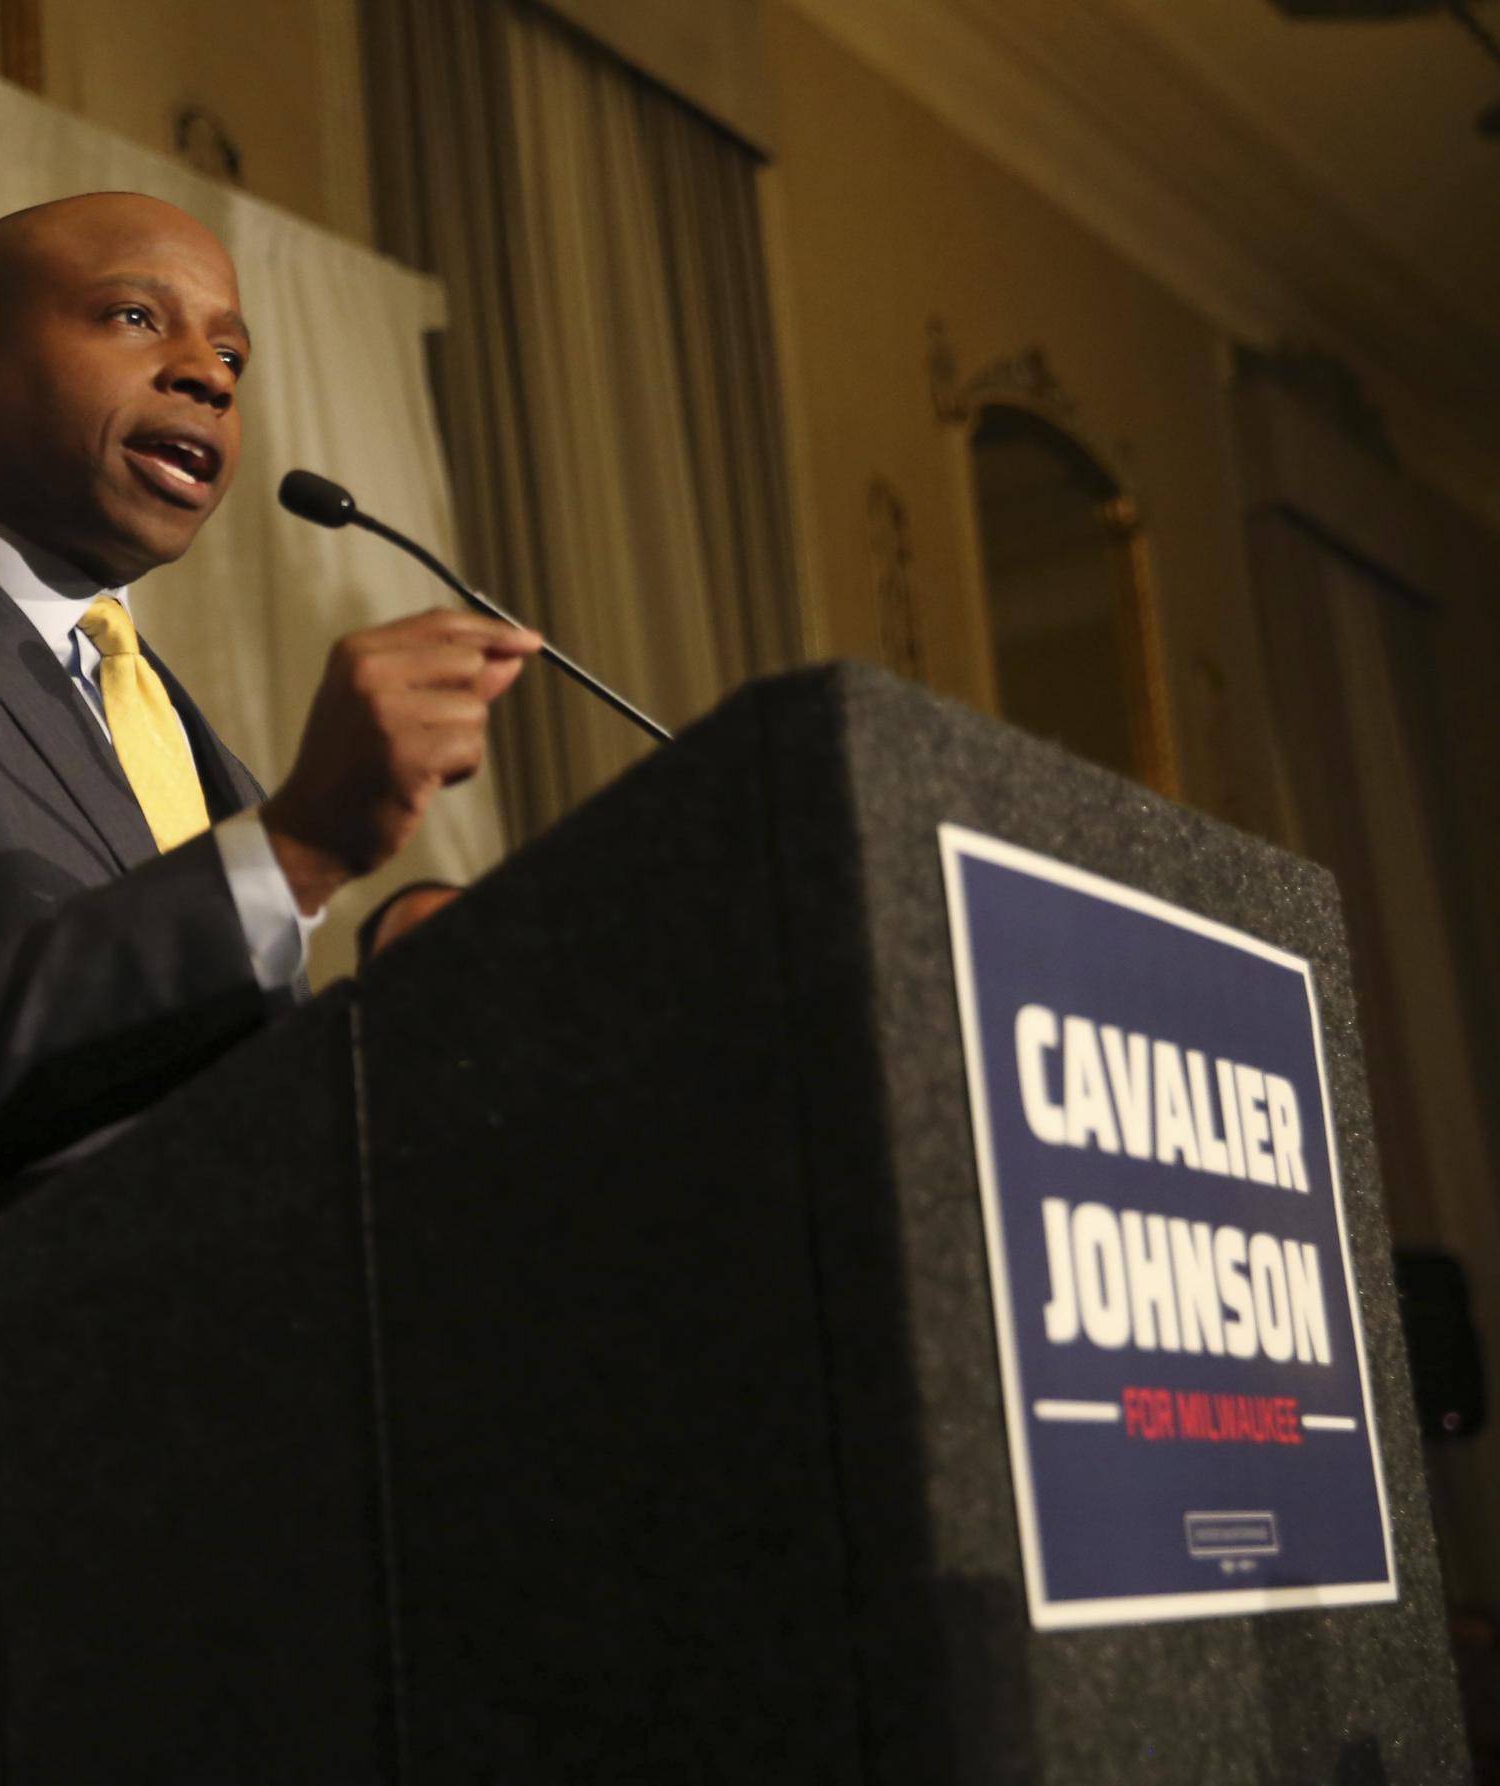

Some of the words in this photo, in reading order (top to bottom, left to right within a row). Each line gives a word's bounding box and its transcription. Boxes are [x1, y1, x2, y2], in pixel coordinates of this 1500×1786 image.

[1015, 1003, 1311, 1195] CAVALIER
[1041, 1196, 1332, 1367] JOHNSON
[1123, 1386, 1176, 1441] FOR
[1174, 1391, 1304, 1445] MILWAUKEE
